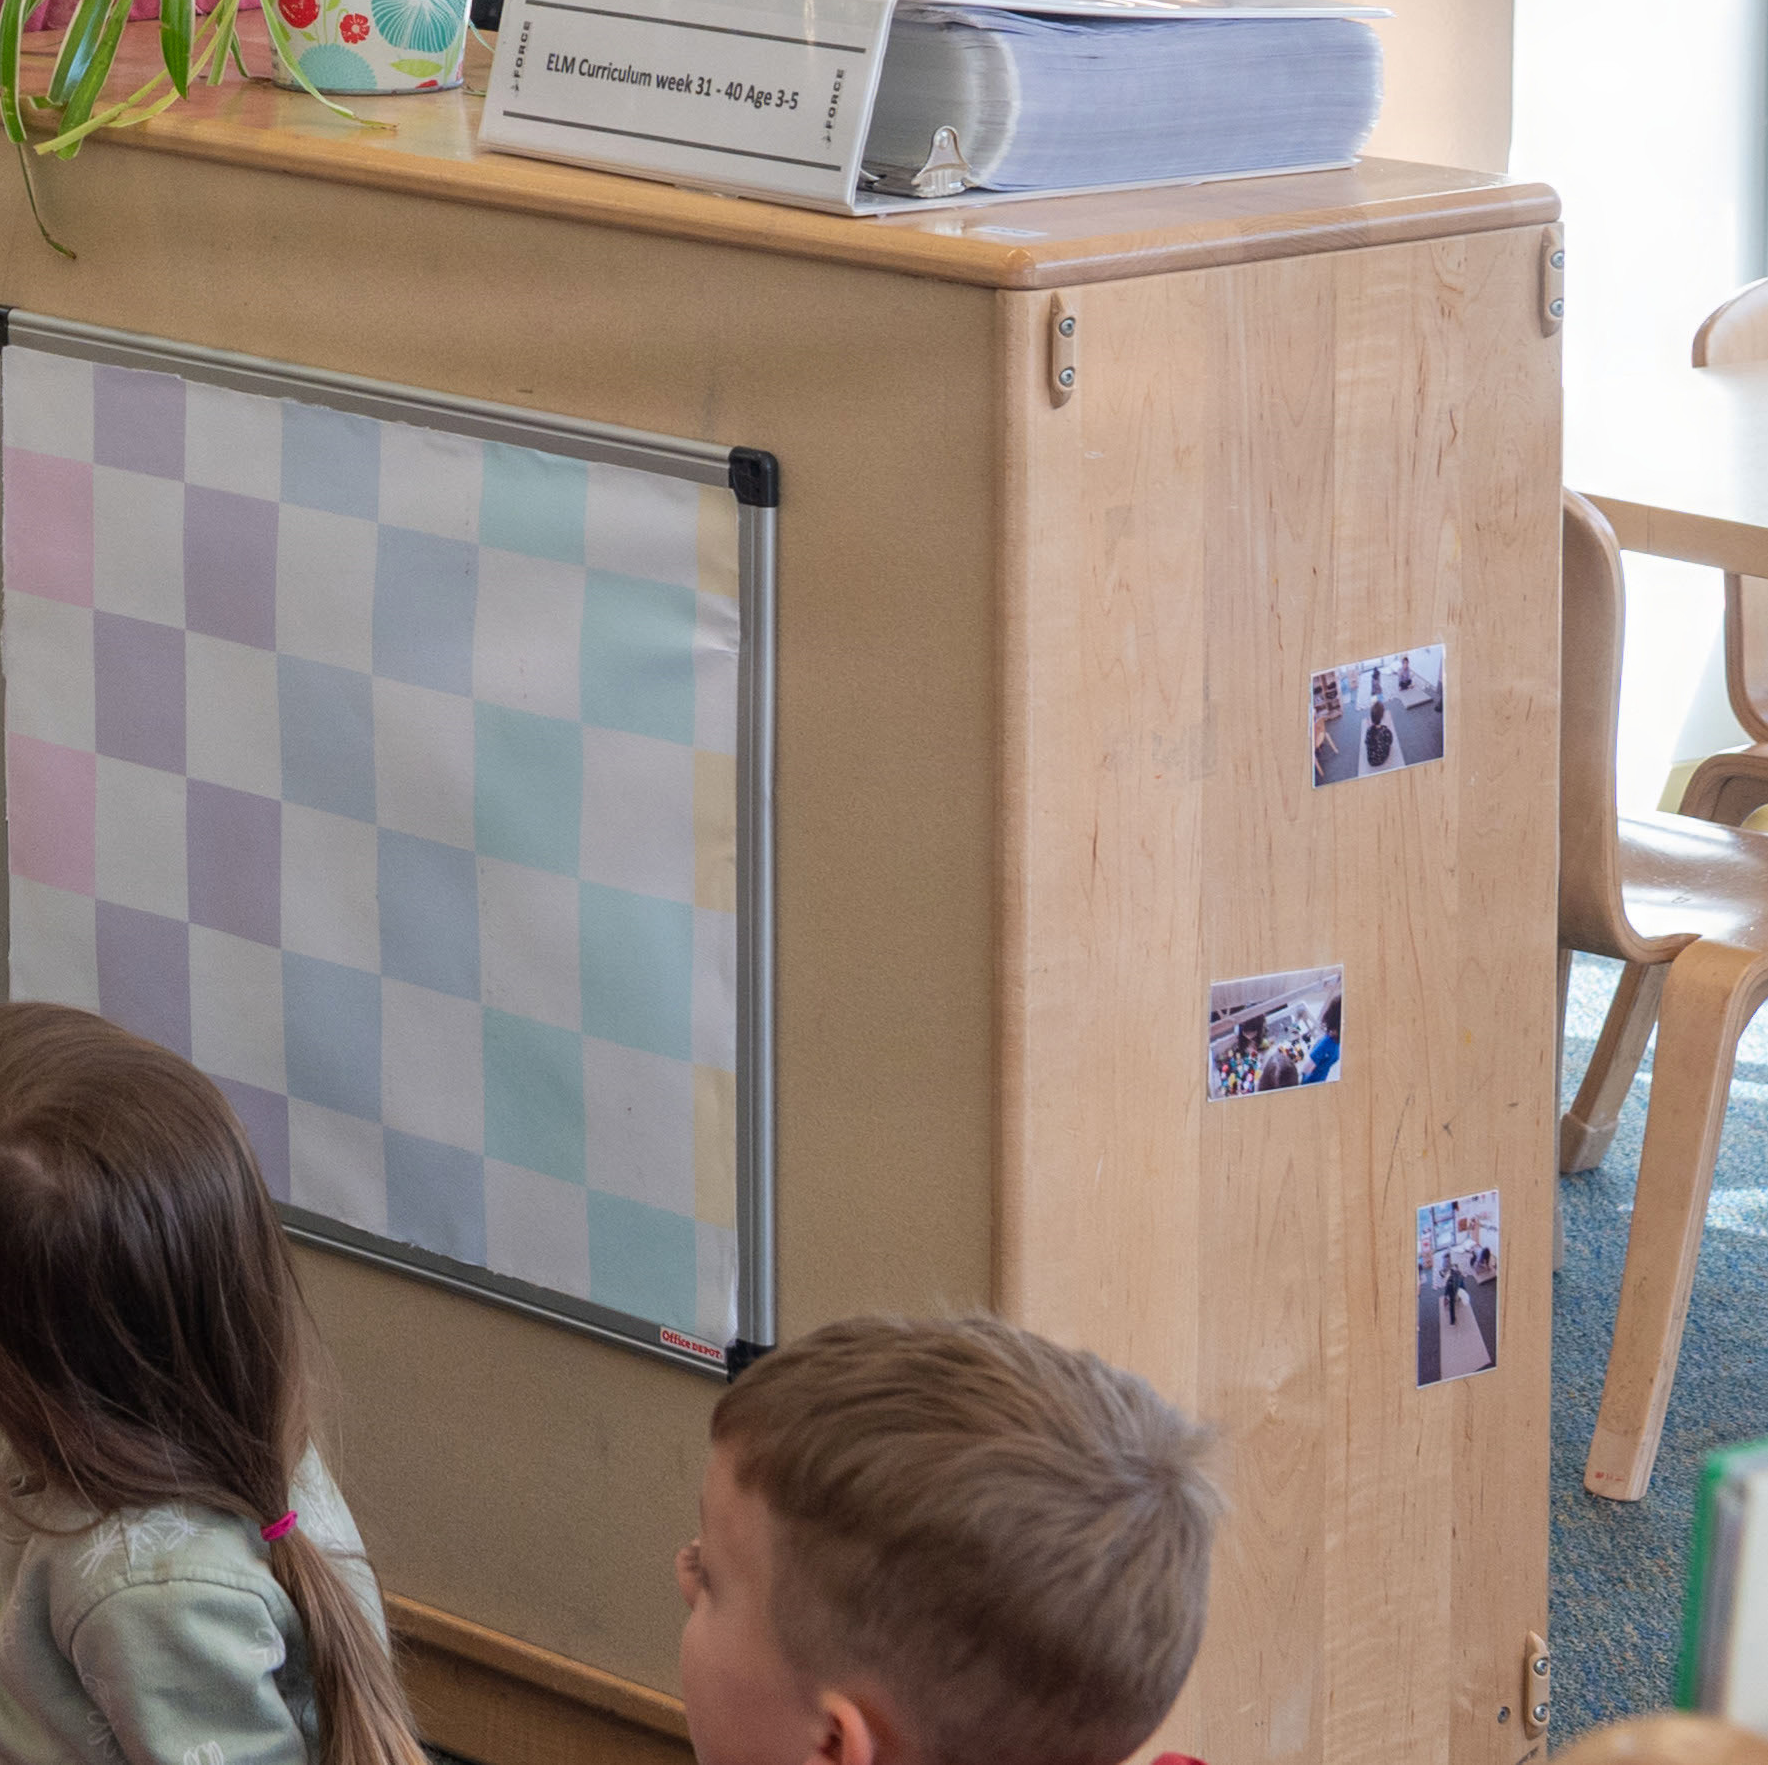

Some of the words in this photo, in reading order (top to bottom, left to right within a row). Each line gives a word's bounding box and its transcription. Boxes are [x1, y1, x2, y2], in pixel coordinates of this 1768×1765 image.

[513, 20, 532, 79] FORCE
[546, 53, 575, 75] ELM
[578, 58, 652, 88] Curriculum
[656, 74, 693, 95] week
[695, 77, 712, 97] 31
[724, 82, 743, 101] 40
[745, 85, 772, 110] Age
[775, 89, 799, 110] 3-5
[825, 68, 845, 131] FORCE
[662, 1330, 691, 1349] Office
[691, 1341, 721, 1359] DEPOT
